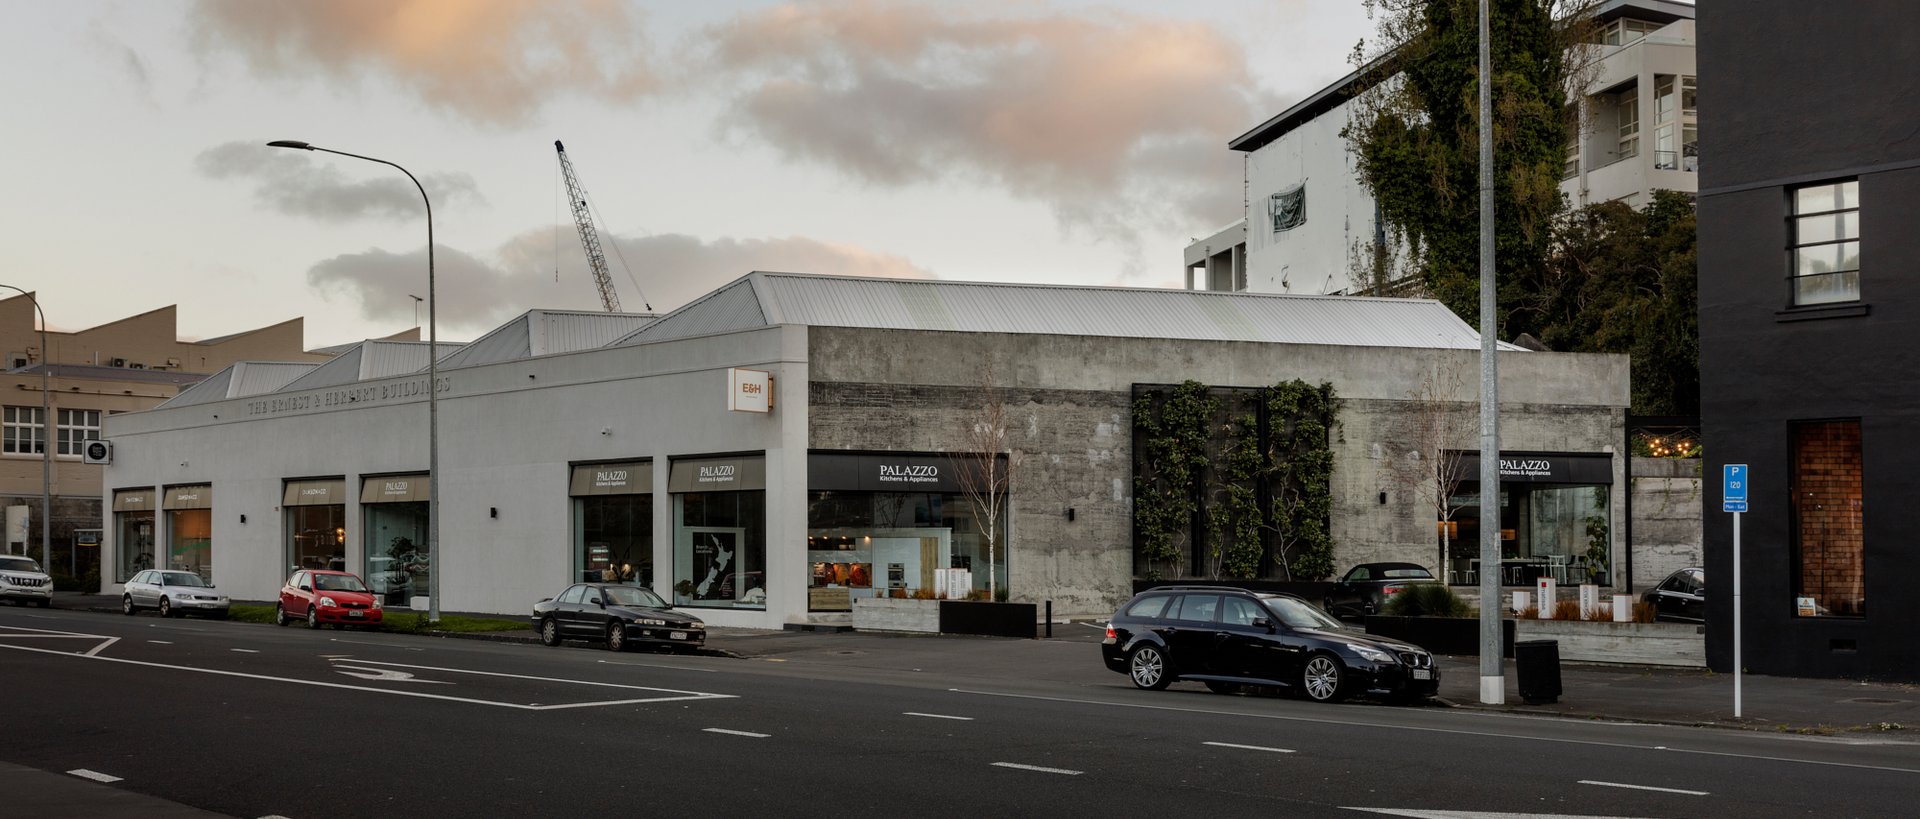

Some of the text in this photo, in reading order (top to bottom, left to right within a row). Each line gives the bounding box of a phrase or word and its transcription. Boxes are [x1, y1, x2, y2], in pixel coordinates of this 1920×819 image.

[742, 383, 761, 394] E&H
[248, 402, 267, 415] THE
[271, 395, 310, 413] ERNEST
[314, 393, 321, 407] &
[325, 387, 376, 406] HERBERT
[1500, 460, 1550, 470] PALAZZO
[700, 465, 735, 476] PALAZZO
[880, 465, 938, 477] PALAZZO
[1731, 467, 1739, 476] P
[597, 471, 627, 481] PALAZZO
[385, 482, 408, 491] PALAZZO
[1730, 481, 1741, 489] 120
